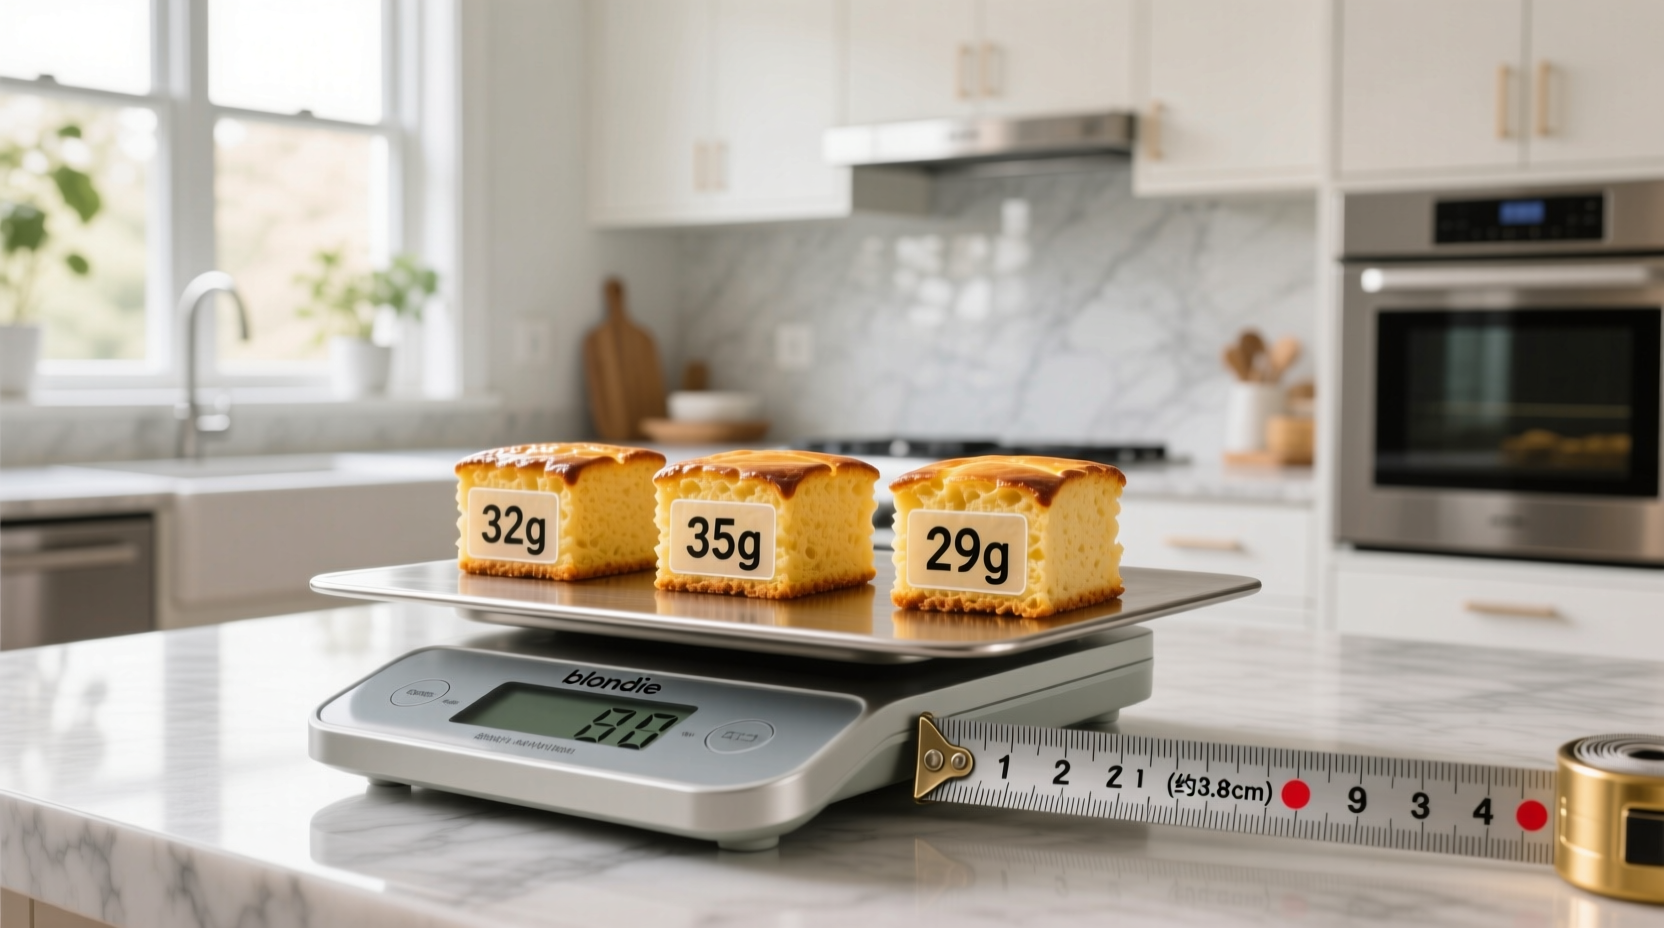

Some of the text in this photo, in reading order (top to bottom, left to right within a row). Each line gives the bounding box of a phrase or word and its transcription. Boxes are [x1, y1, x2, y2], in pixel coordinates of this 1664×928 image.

[481, 504, 546, 555] 32g
[687, 516, 761, 571] 35g
[926, 526, 1009, 585] 29g
[562, 669, 662, 694] blondie
[998, 754, 1011, 780] 1
[1052, 759, 1071, 785] 2
[1347, 786, 1367, 814] 9
[1410, 791, 1430, 820] 3
[1472, 798, 1494, 826] 4
